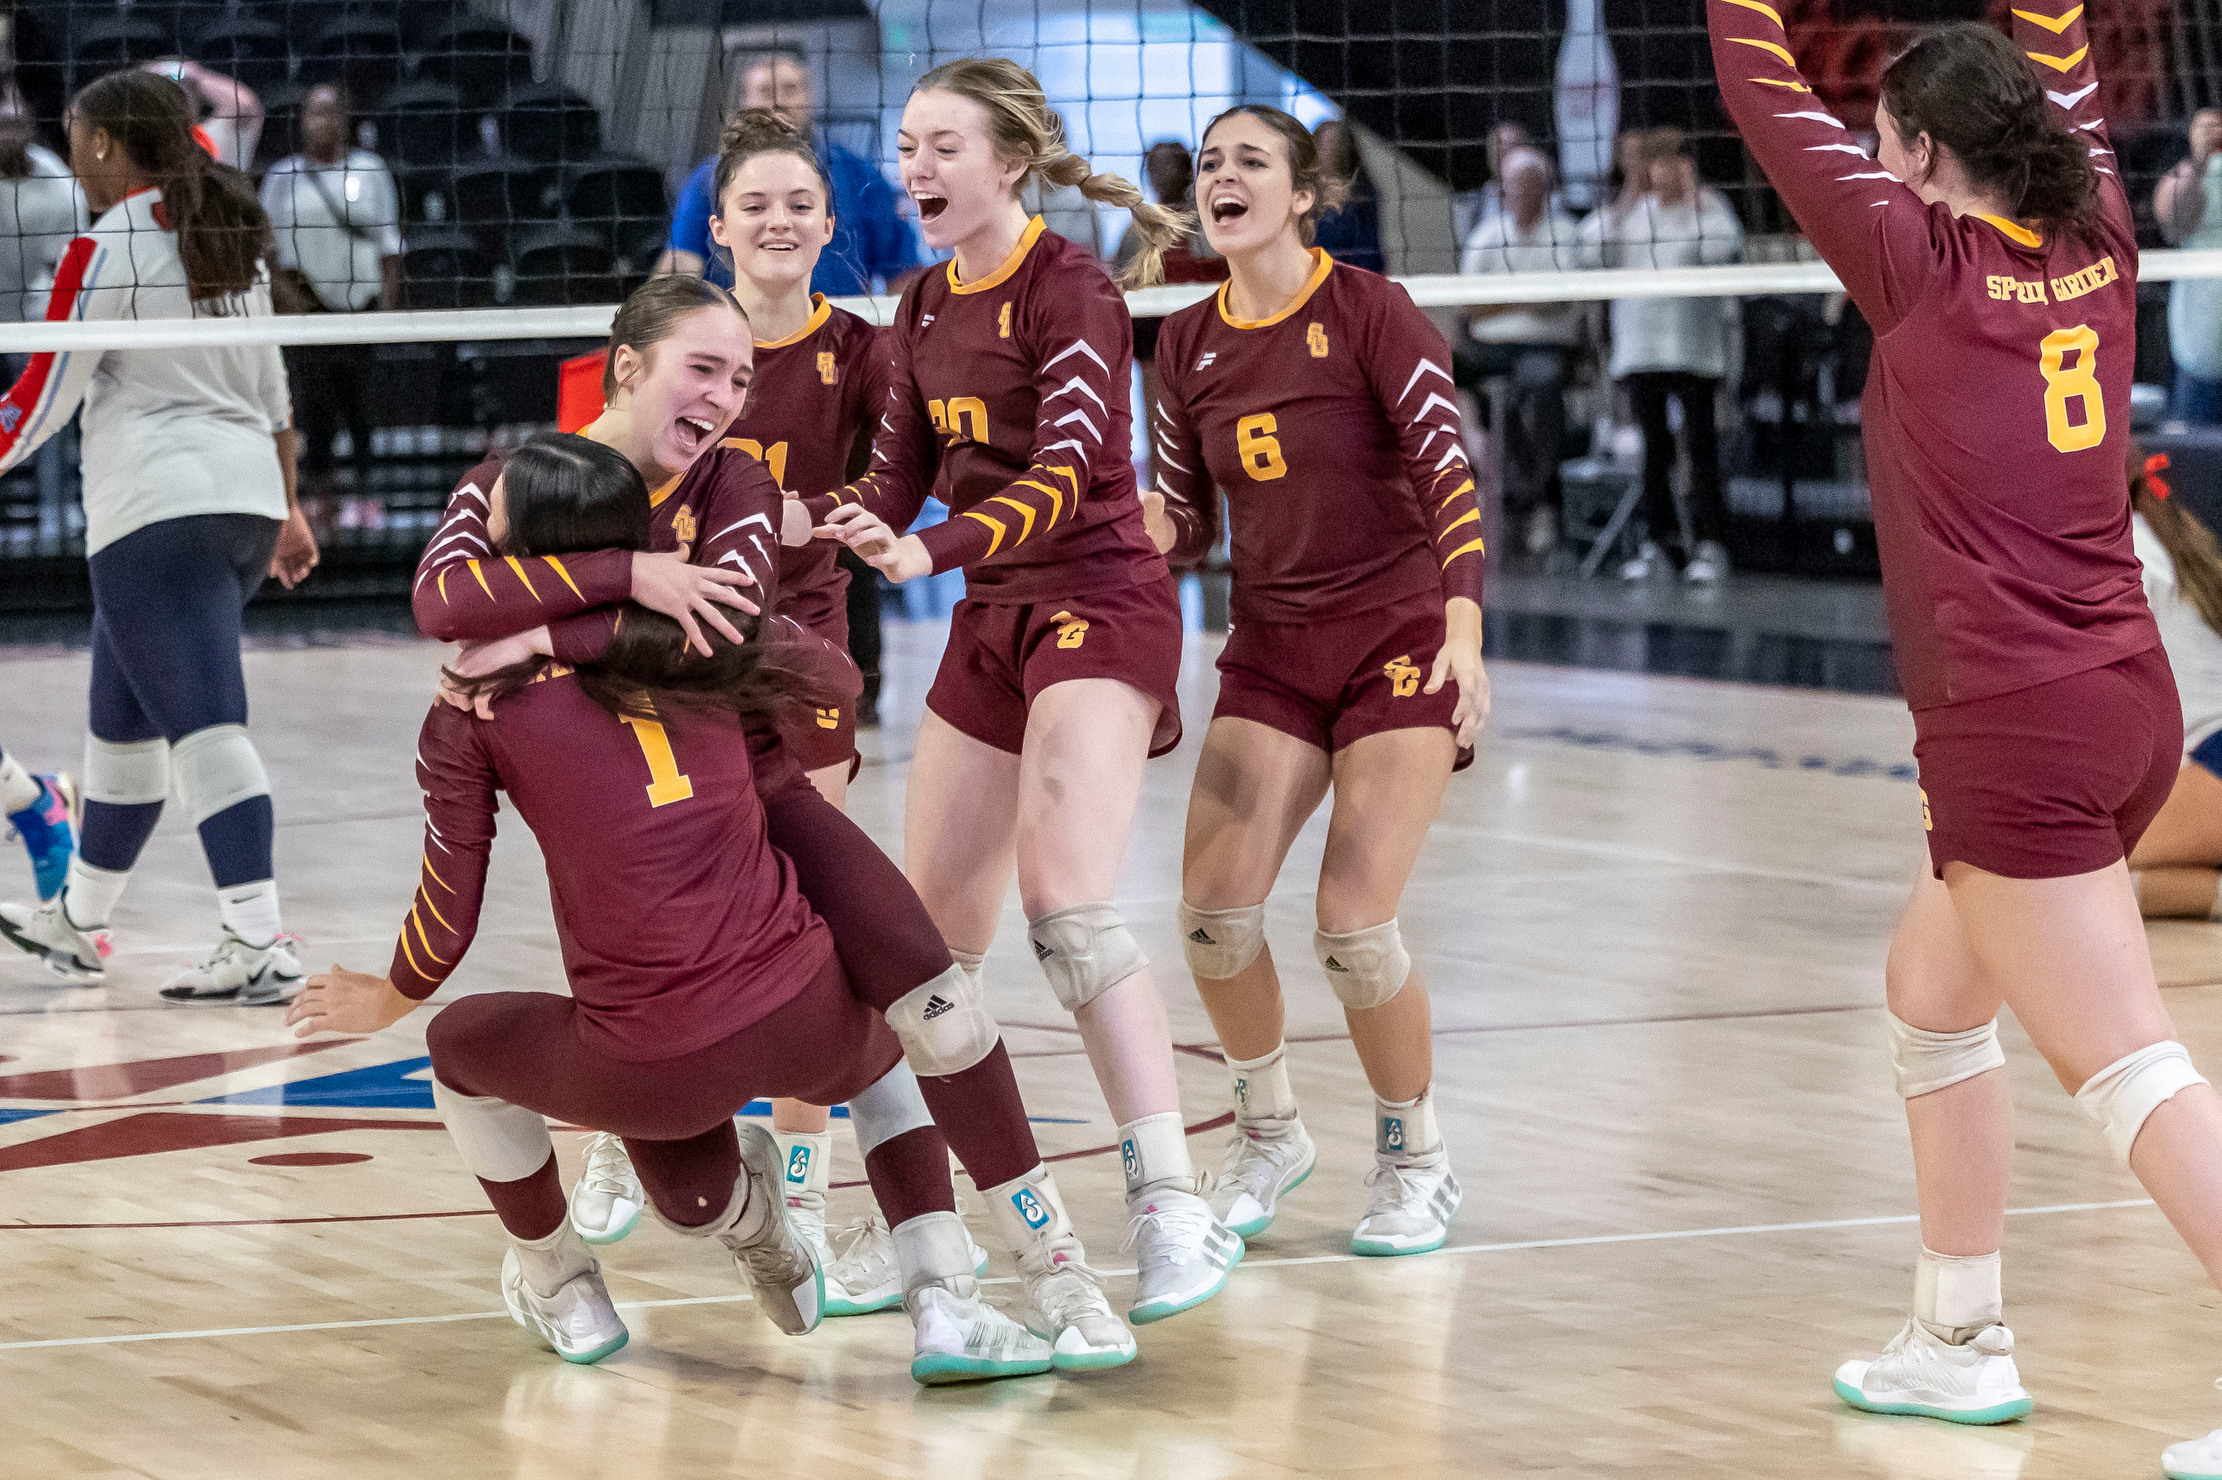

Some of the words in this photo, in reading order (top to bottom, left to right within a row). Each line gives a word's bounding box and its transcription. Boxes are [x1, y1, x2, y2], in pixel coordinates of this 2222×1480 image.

[2039, 323, 2107, 454] 8
[1236, 412, 1288, 482] 6
[617, 690, 694, 808] 1
[923, 1002, 955, 1021] adidas
